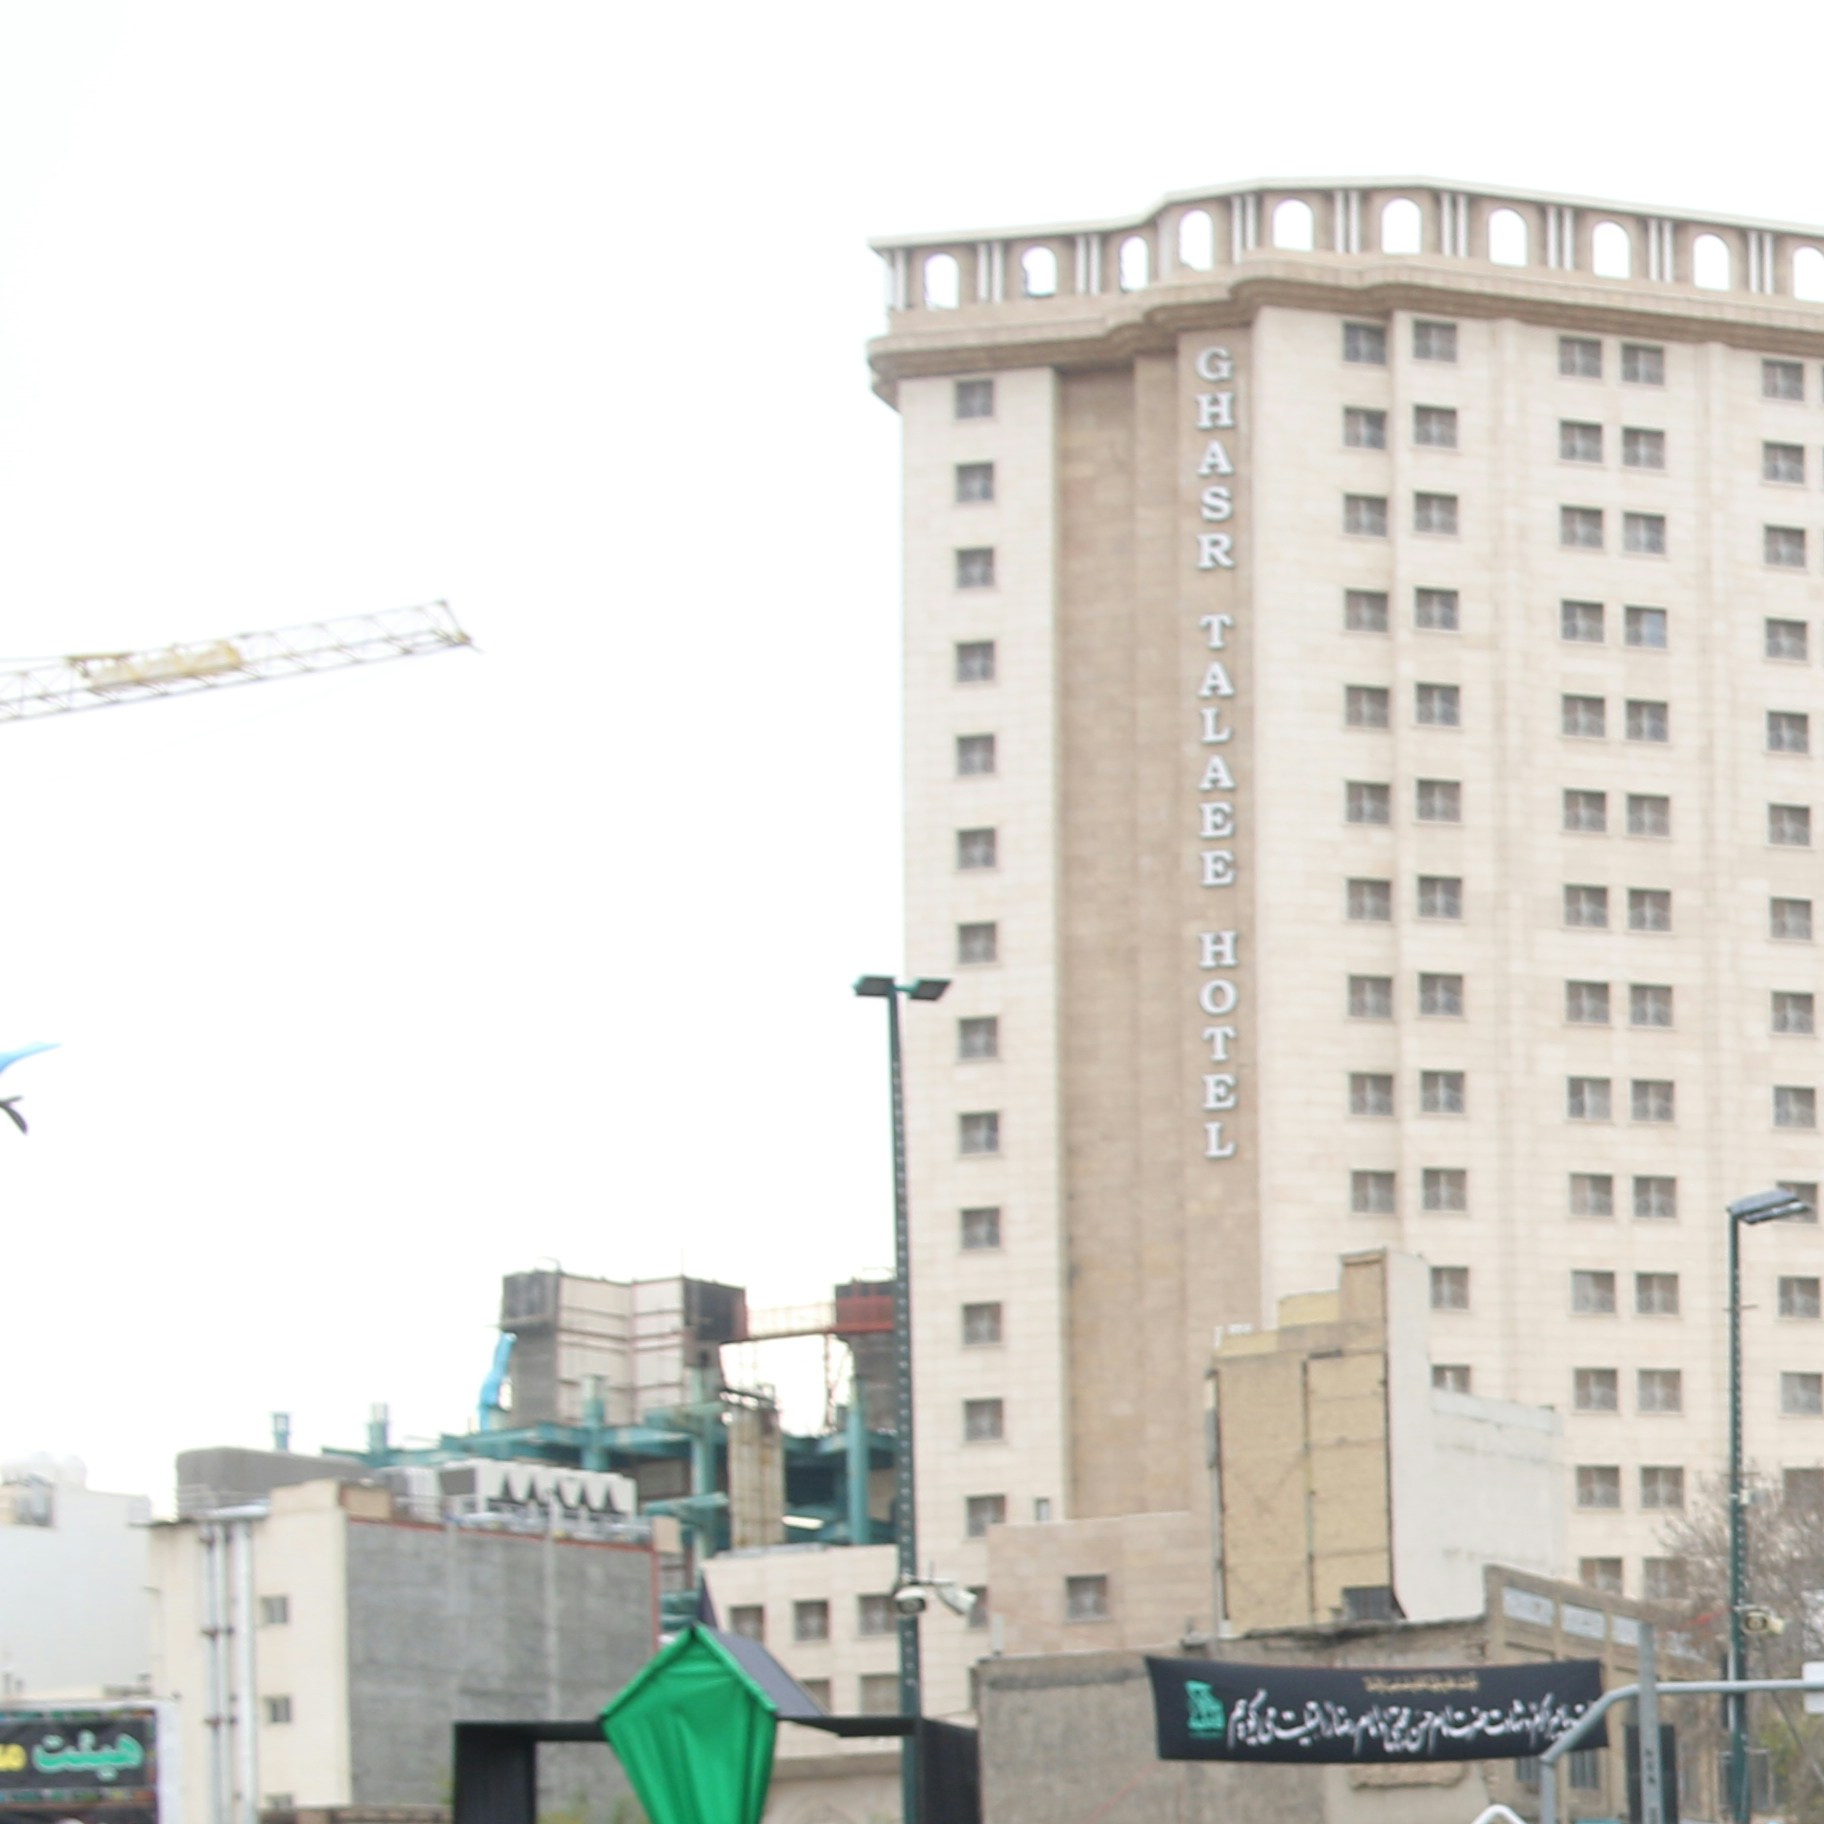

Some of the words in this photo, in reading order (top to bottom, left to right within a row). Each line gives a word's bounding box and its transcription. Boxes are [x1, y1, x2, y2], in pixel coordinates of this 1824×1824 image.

[1196, 347, 1236, 571] GHASR
[1199, 612, 1237, 886] TALAEE
[1199, 930, 1239, 1160] HOTEL
